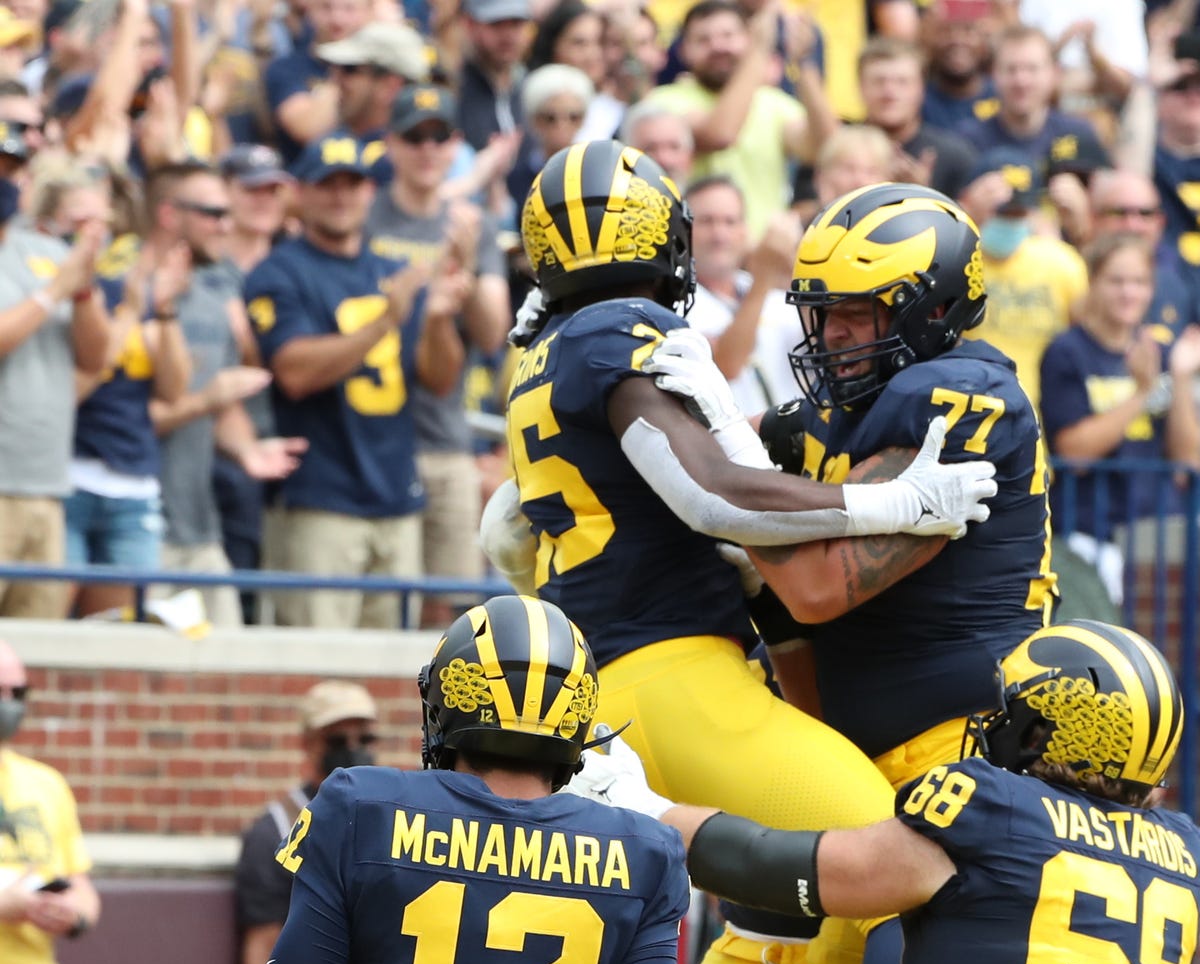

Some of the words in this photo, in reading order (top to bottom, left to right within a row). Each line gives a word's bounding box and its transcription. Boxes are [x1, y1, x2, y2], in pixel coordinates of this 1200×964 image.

[931, 387, 1006, 454] 77
[480, 708, 493, 723] 12
[903, 766, 977, 829] 68
[1104, 765, 1121, 780] 68
[390, 809, 631, 890] McNAMARA
[1041, 796, 1198, 879] VASTARDIS
